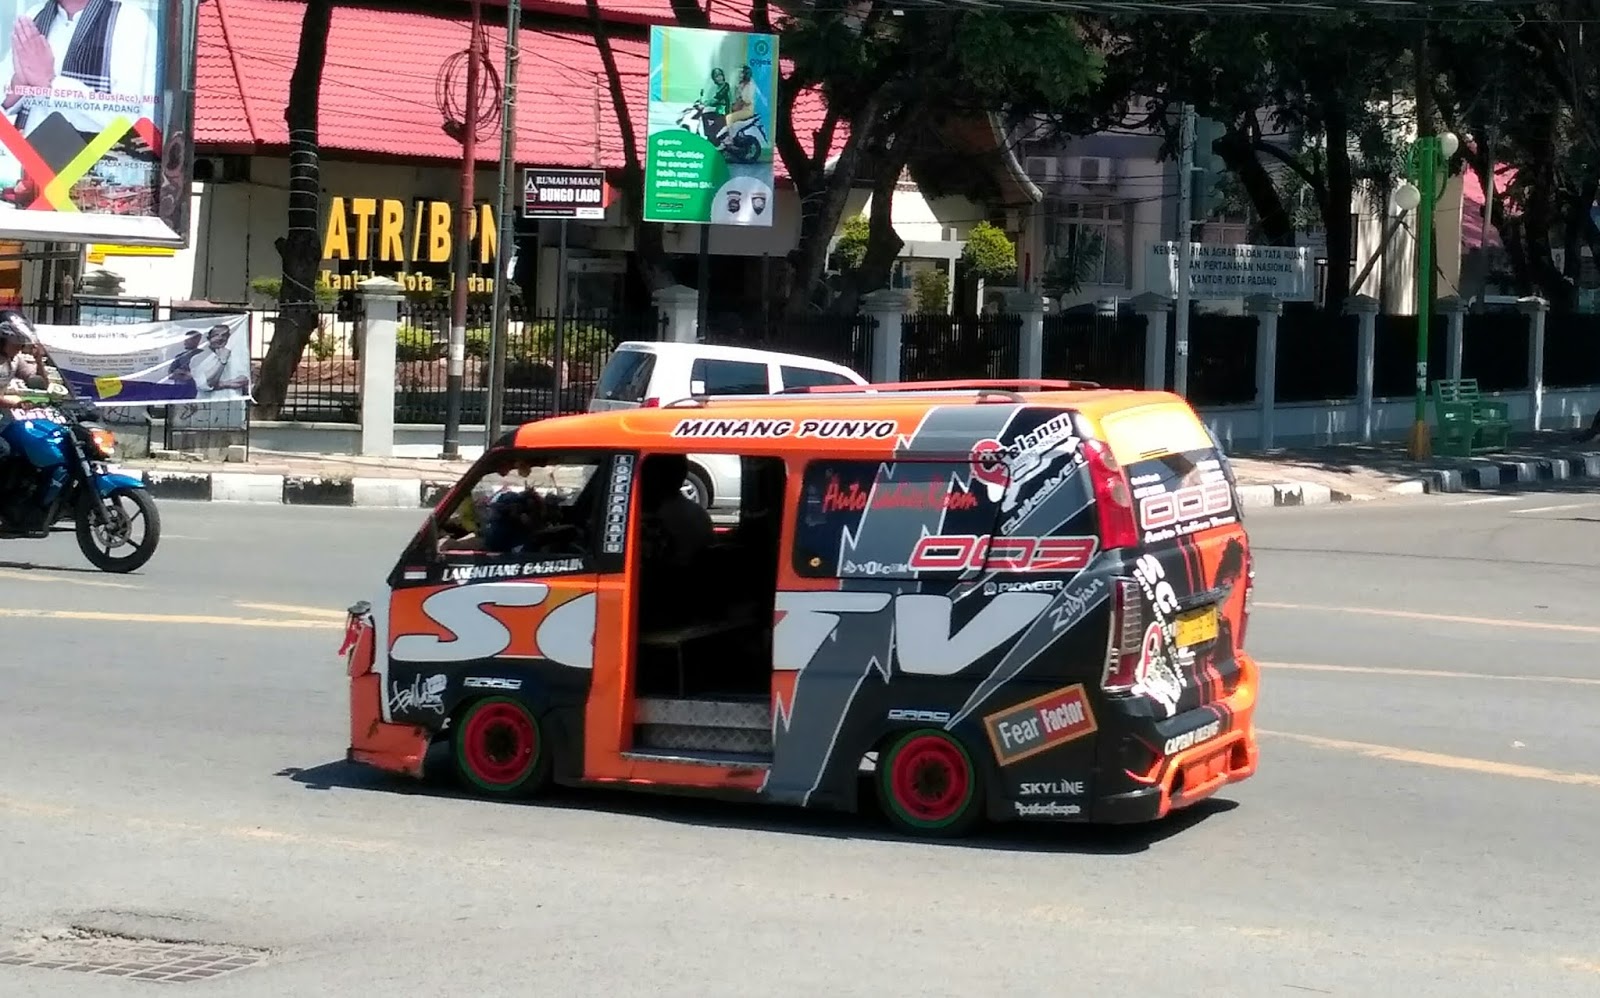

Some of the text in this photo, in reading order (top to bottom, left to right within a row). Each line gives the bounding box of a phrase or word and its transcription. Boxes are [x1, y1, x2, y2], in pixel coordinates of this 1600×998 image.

[22, 99, 141, 114] WAKIL WALIKOTA PADANG
[536, 176, 601, 186] RUMAH MAKAN
[1212, 247, 1246, 258] AGRARIA
[1247, 248, 1262, 259] DAN
[1264, 249, 1282, 259] TATA
[1256, 262, 1293, 273] NASIONAL
[1191, 274, 1277, 286] KANTOR KOTA PADANG
[673, 419, 896, 439] MINANG PUNYO
[998, 580, 1064, 593] PIONEER
[998, 700, 1086, 748] Fear Factor
[1019, 778, 1085, 795] SKYLINE
